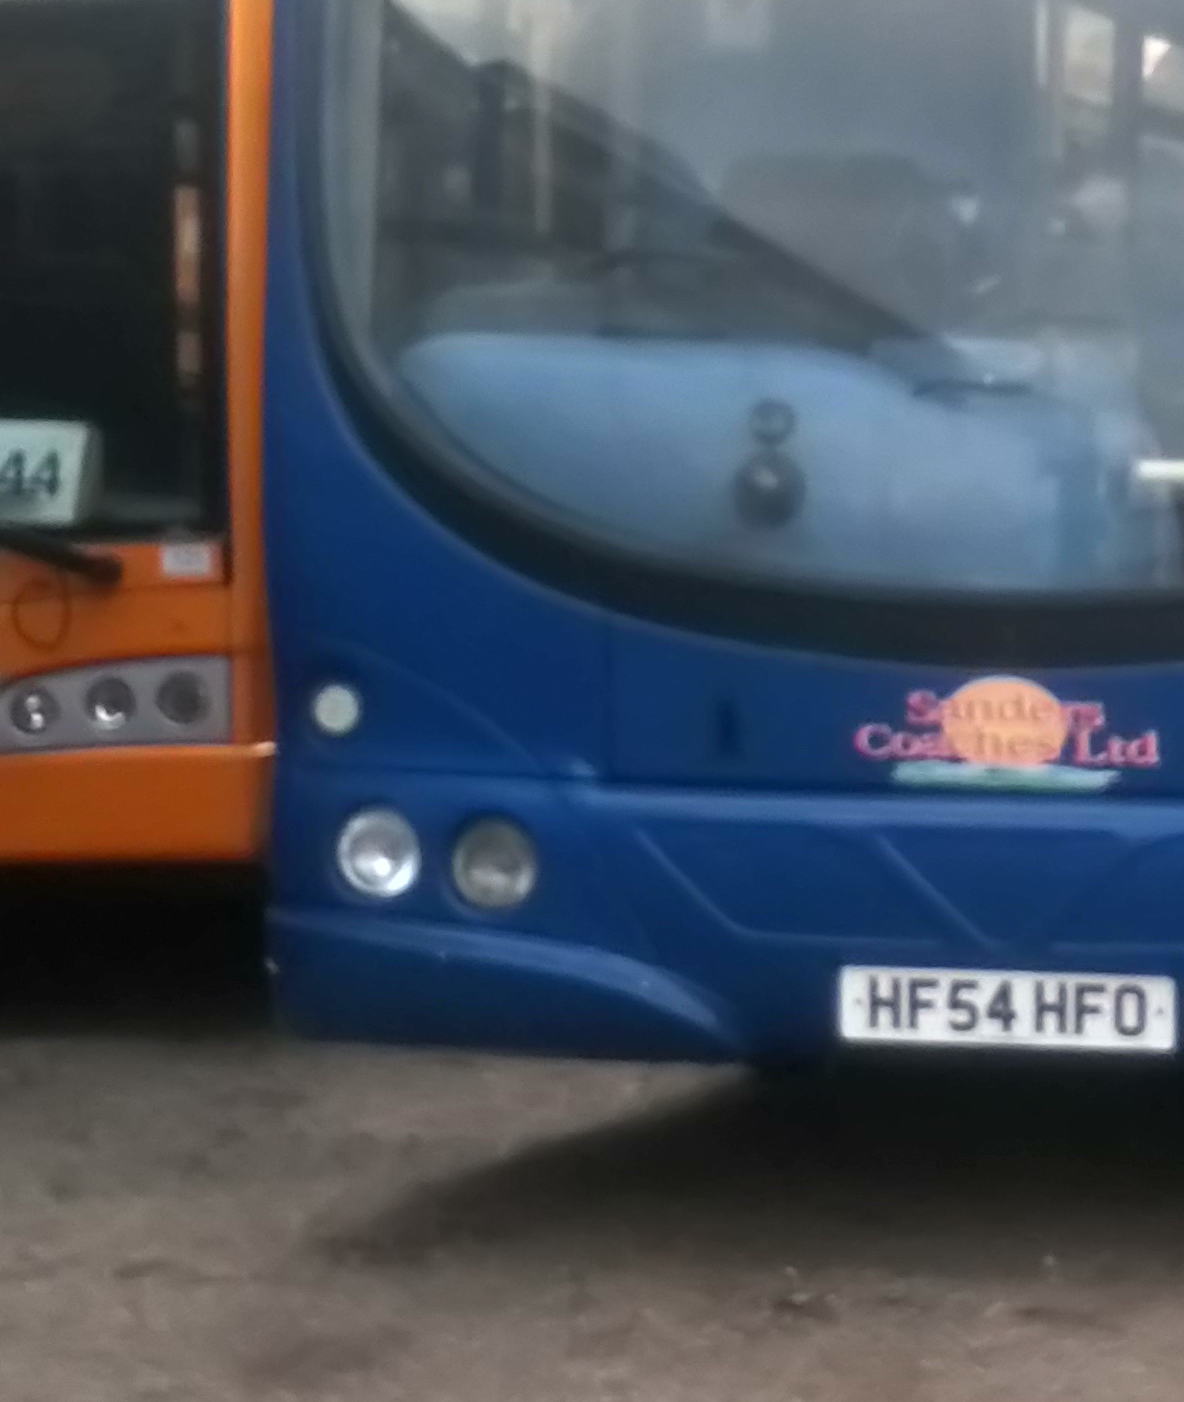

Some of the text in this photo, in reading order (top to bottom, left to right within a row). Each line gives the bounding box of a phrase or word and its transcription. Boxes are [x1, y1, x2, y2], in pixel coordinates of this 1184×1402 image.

[1073, 727, 1161, 768] Ltd
[868, 974, 1147, 1037] HF54 HFO
